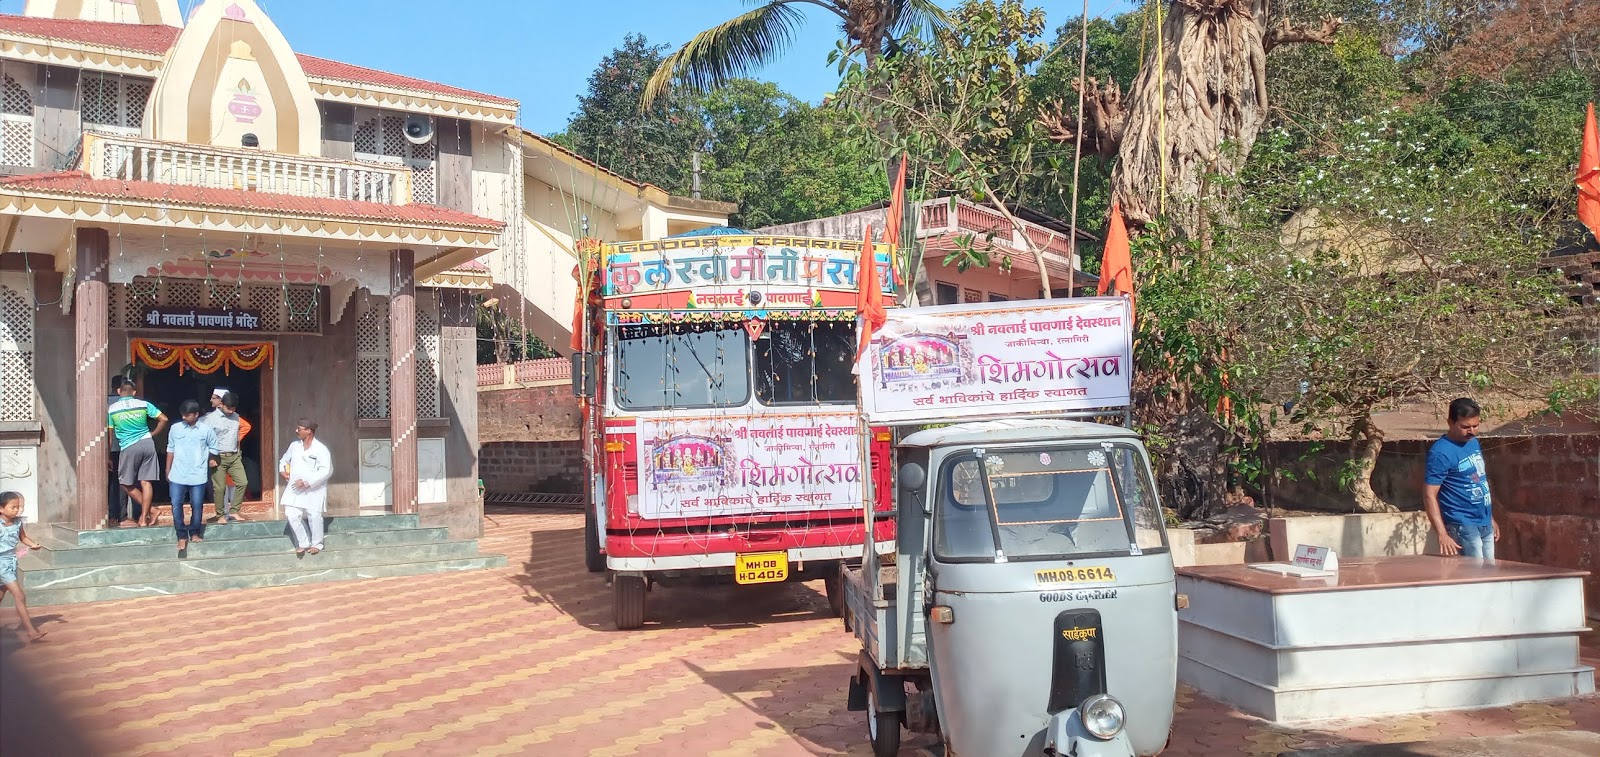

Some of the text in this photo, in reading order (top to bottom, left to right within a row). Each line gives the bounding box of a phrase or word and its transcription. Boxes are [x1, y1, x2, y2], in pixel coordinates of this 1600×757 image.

[618, 239, 718, 253] GOODS
[146, 310, 258, 329] श्री नवलाई पावणाई मंदिर
[970, 315, 1121, 336] श्री नवलाई पावणाई देवस्थान
[1056, 334, 1089, 345] रत्नागिरी
[977, 350, 1121, 385] शिमगोत्सव
[913, 387, 1087, 406] सर्व भाविकांचे हार्दिक स्वागत
[734, 426, 747, 439] श्री
[750, 424, 784, 439] नवलाई
[739, 456, 861, 488] शिमगोत्सव
[681, 496, 700, 508] सर्व
[757, 492, 792, 505] हार्दिक
[796, 492, 832, 503] स्वागत
[1039, 591, 1073, 602] GOODS
